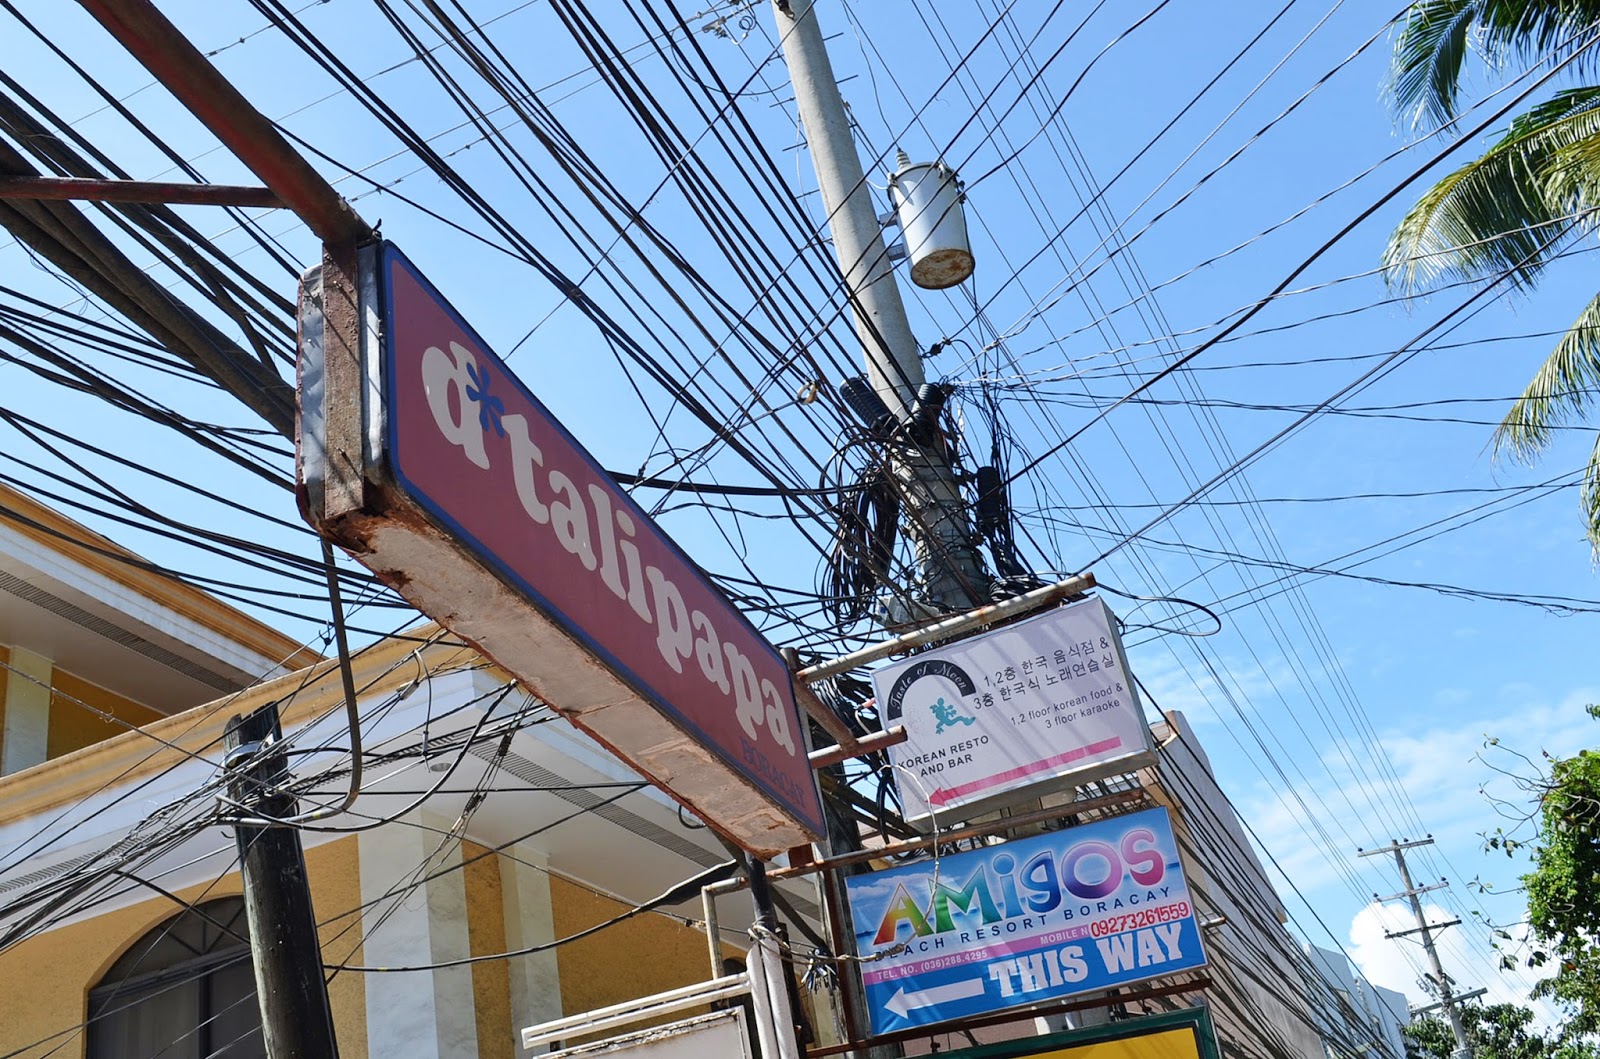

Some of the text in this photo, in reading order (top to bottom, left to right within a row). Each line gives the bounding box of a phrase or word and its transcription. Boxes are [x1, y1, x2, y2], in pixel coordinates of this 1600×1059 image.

[973, 652, 1115, 710] 3층 한국식 노래연습실
[984, 636, 1110, 687] 1,2층 한국 음식점 &
[891, 662, 967, 710] Taste of Moon
[1011, 682, 1124, 726] 1,2 floor korean food &
[1045, 698, 1121, 729] 3 floor karaoke
[898, 735, 989, 771] KOREAN RESTO
[920, 753, 974, 778] AND BAR
[960, 914, 1047, 944] RESORT
[1064, 886, 1170, 921] BORACAY
[1091, 901, 1190, 938] 09273261559
[877, 966, 898, 981] TEL.
[900, 965, 918, 975] NO.
[1039, 930, 1078, 946] MOBILE
[988, 922, 1184, 998] THIS WAY
